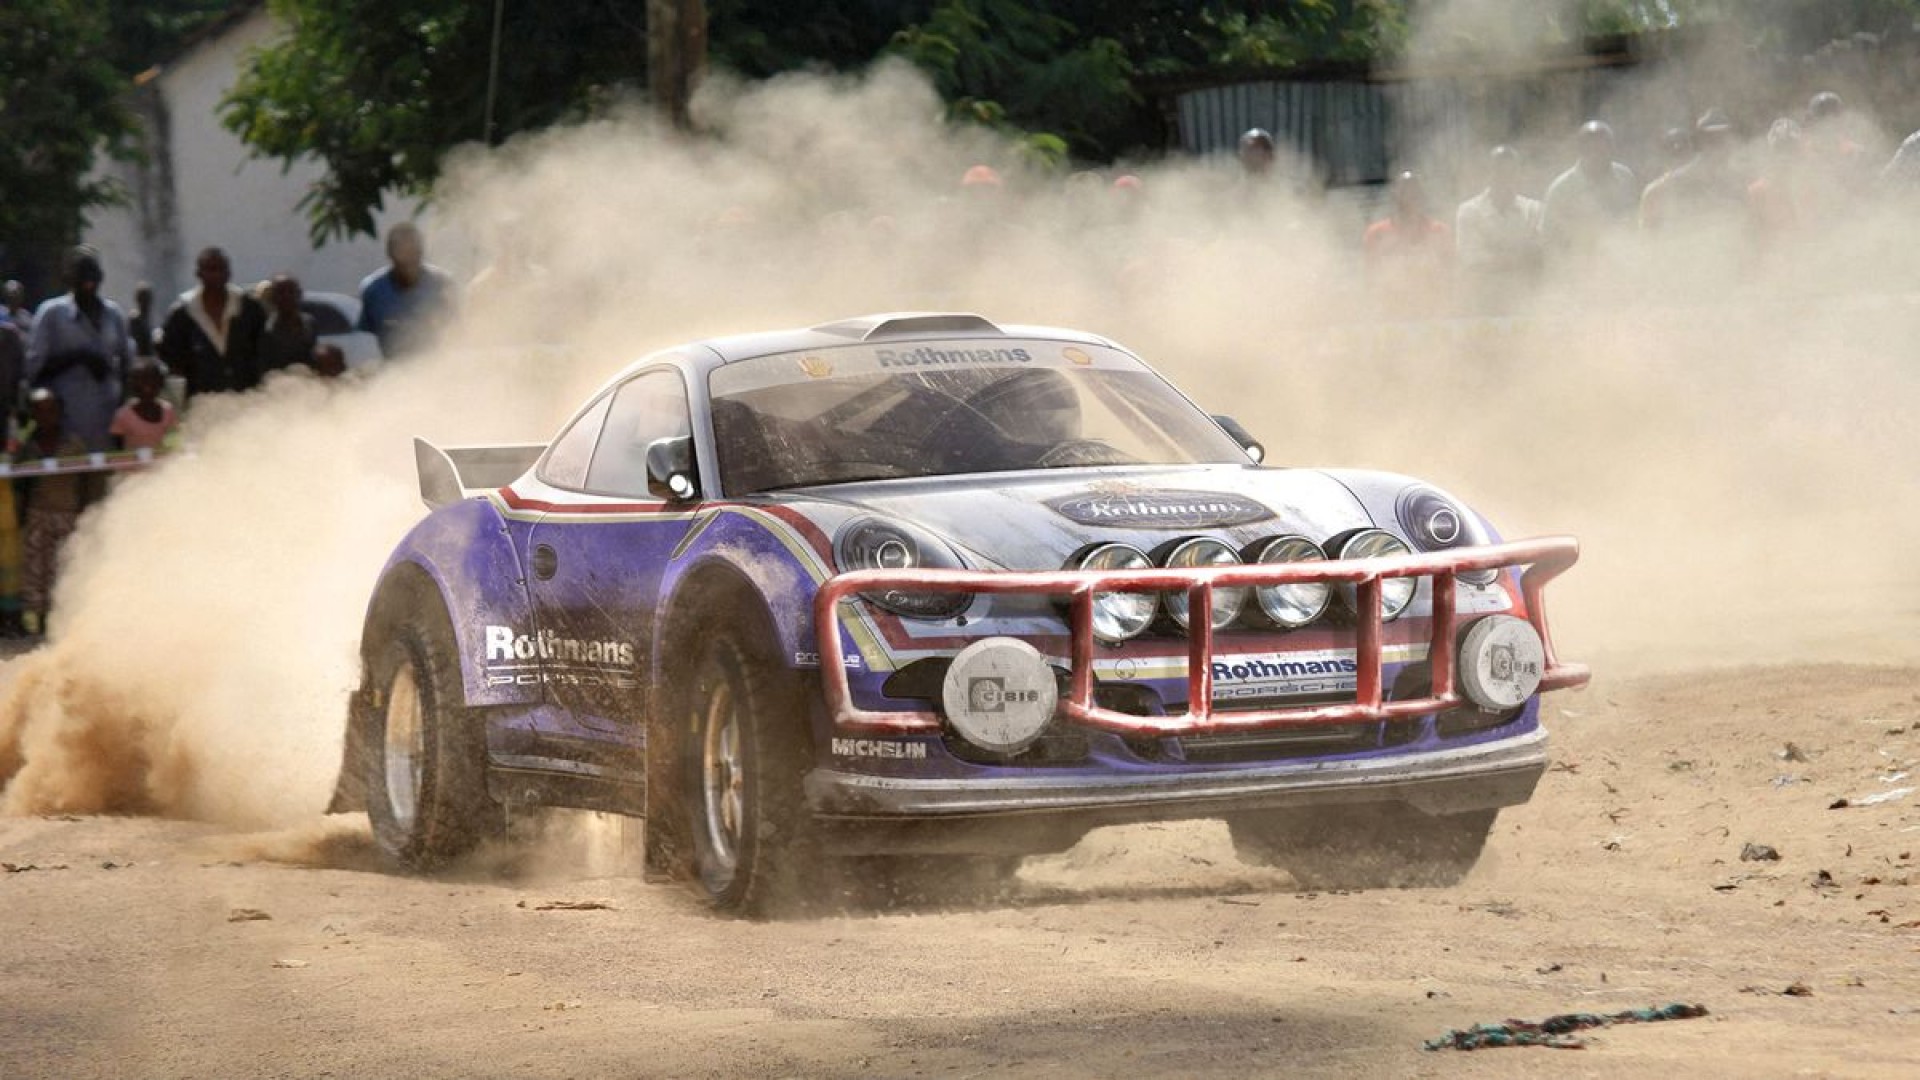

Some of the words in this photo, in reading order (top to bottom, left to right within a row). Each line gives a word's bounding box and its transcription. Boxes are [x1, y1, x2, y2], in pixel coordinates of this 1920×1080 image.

[875, 346, 1033, 368] Rothmans
[485, 625, 635, 665] Rothmans
[1212, 658, 1358, 681] Rothmans
[1213, 681, 1358, 697] PORSCHE
[831, 737, 927, 758] MICHELIN
